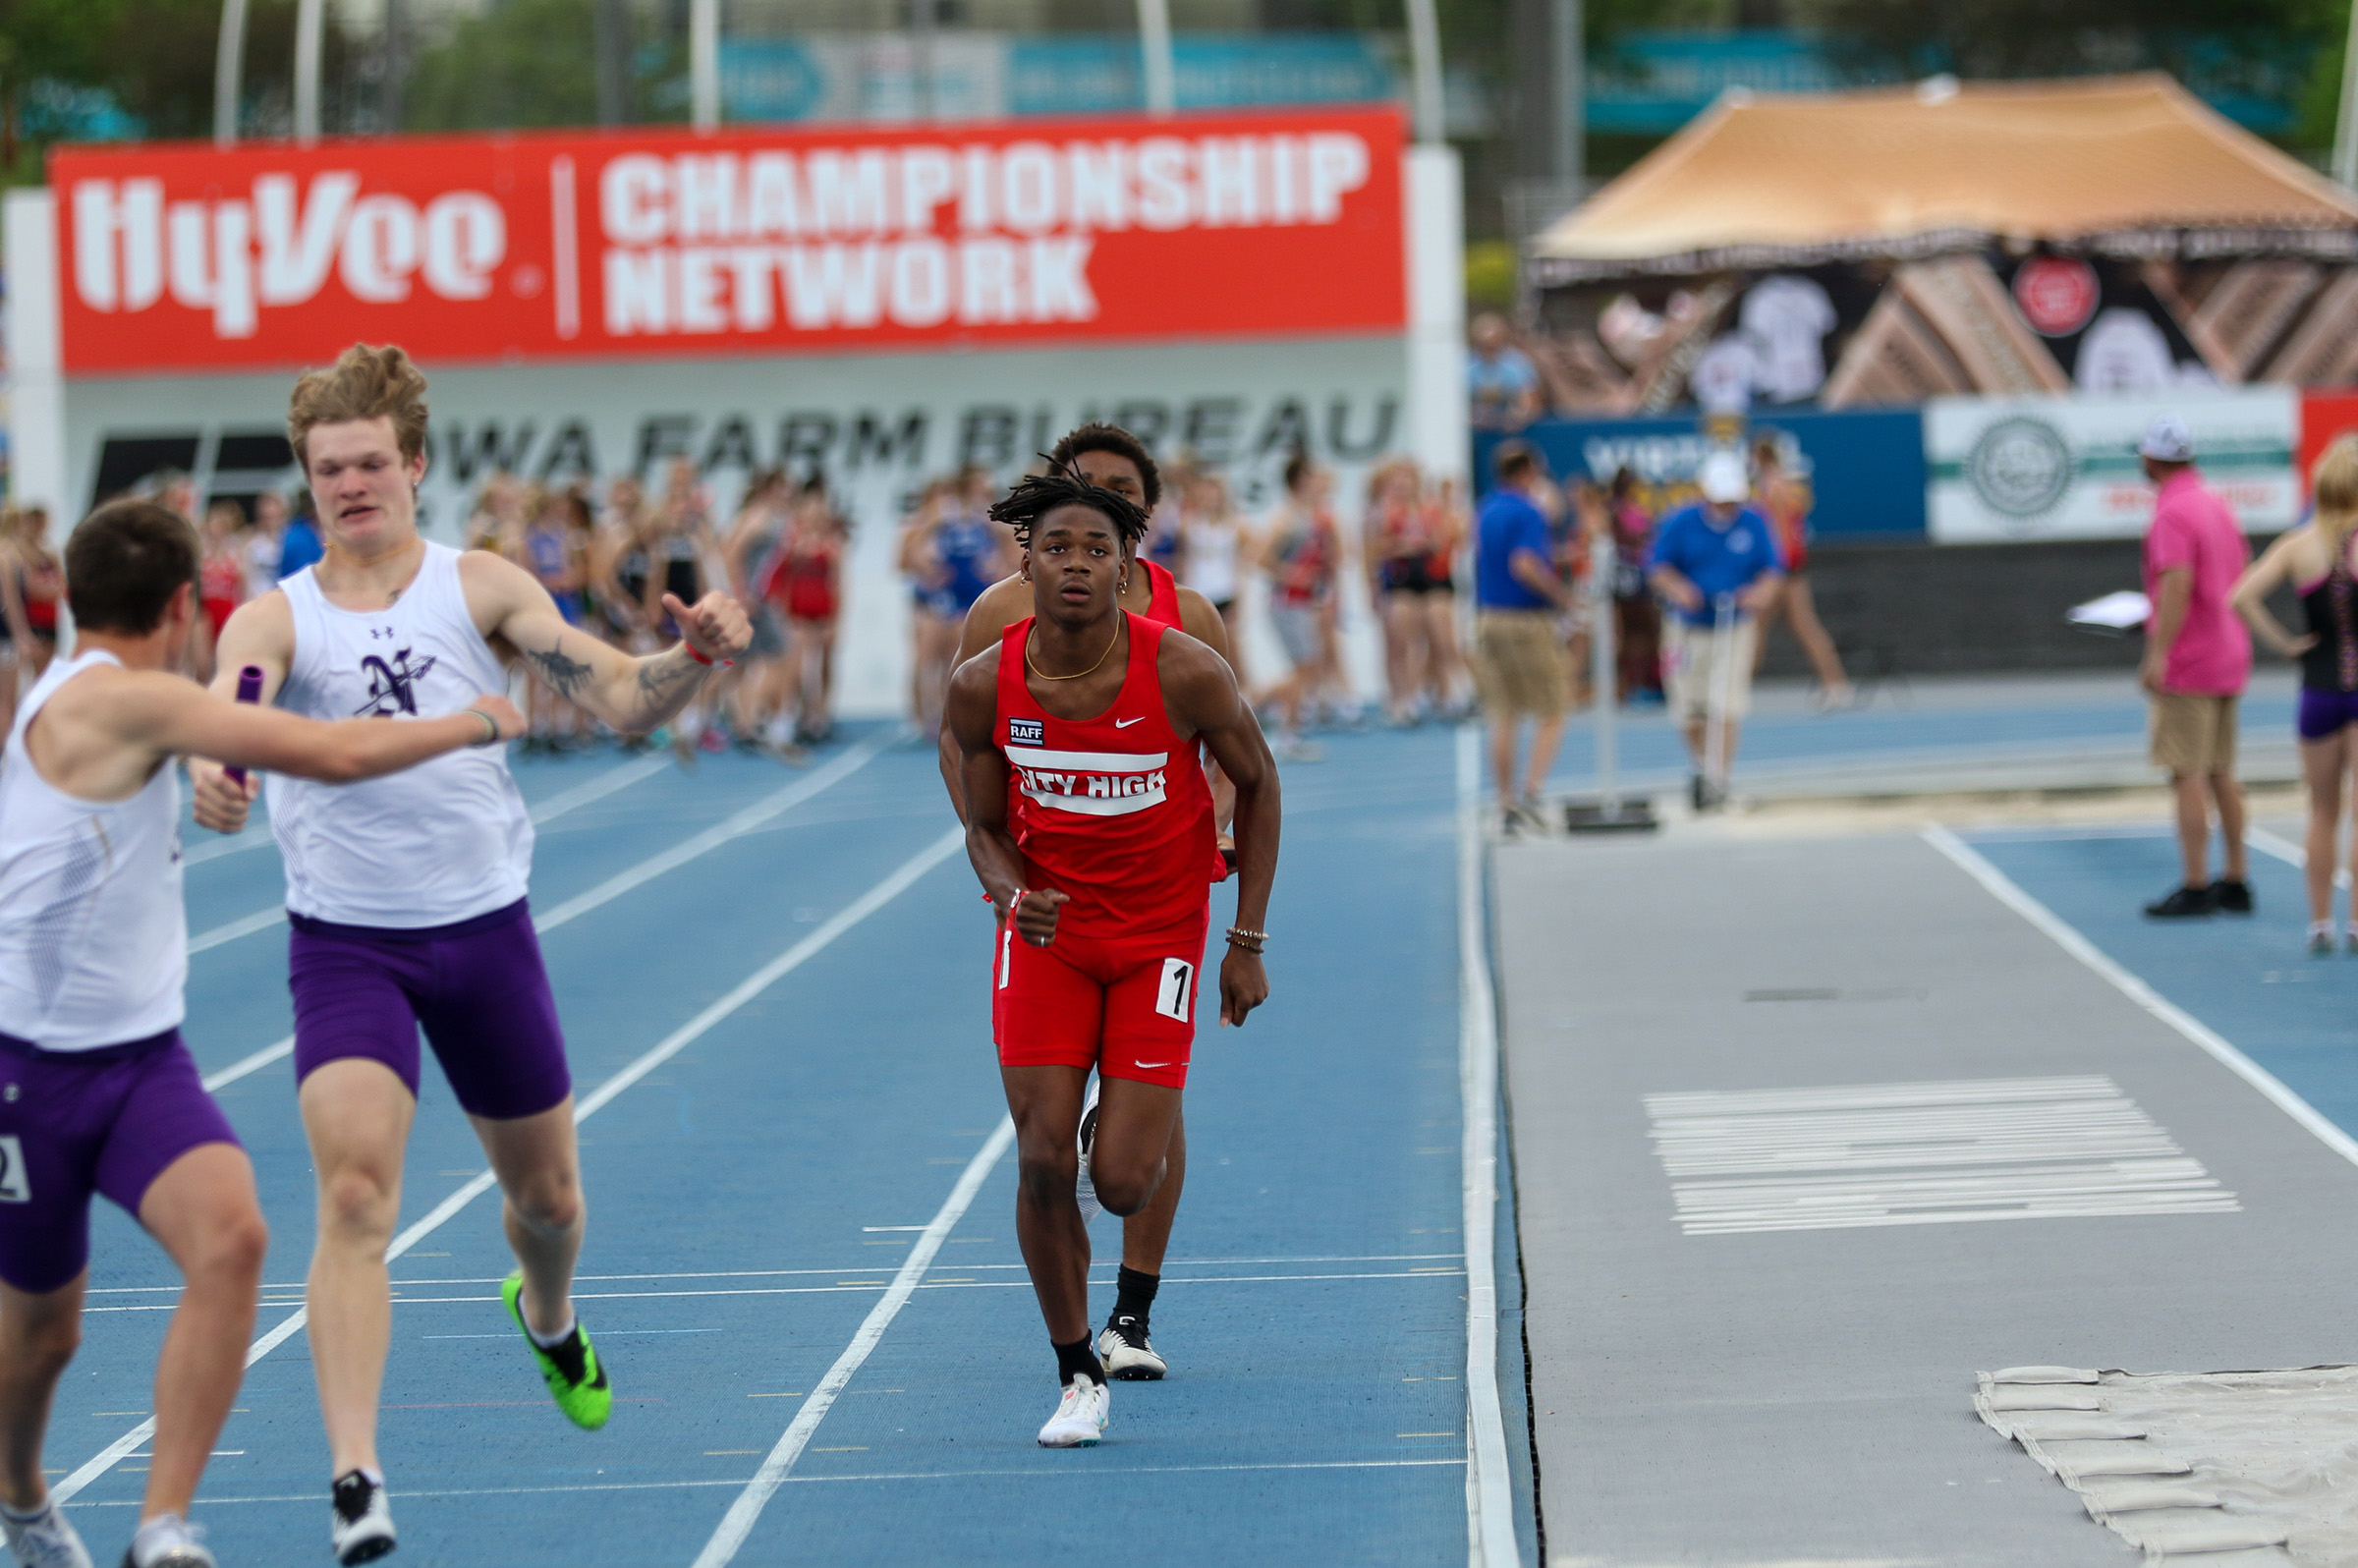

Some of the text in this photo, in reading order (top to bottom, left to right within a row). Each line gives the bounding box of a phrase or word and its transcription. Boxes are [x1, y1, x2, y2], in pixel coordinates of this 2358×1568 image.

[598, 132, 1371, 247] CHAMPIONSHIP
[601, 236, 1098, 336] NETWORK
[634, 408, 929, 479] FARM
[1010, 725, 1043, 739] RAFF
[1087, 770, 1167, 798] HIGH
[1173, 965, 1189, 1016] 1
